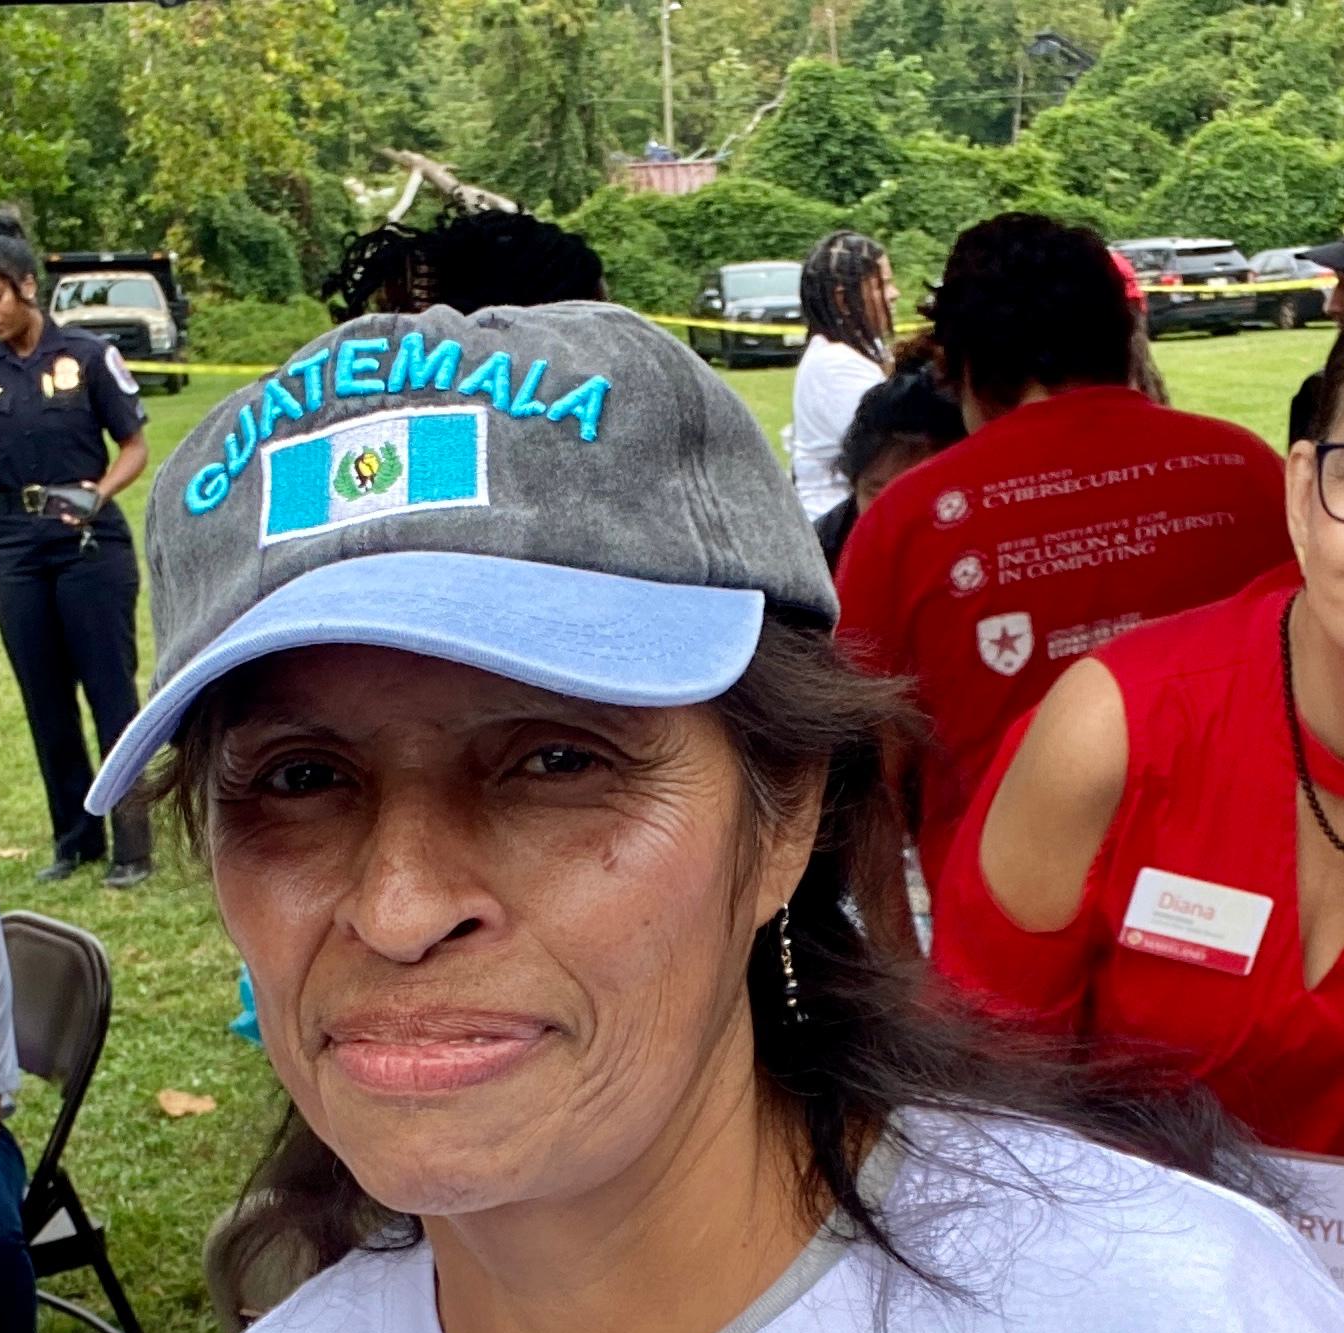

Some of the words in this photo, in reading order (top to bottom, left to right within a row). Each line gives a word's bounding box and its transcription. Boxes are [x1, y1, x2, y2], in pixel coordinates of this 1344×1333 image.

[184, 331, 611, 515] GUATEMALA
[983, 463, 1157, 509] CYBERSECURITY
[1165, 453, 1246, 471] CENTER
[984, 469, 1072, 493] MARYLAND
[998, 536, 1109, 569] INCLUSION
[1114, 533, 1129, 545] &
[1135, 511, 1237, 540] DIVERSITY
[999, 567, 1022, 585] IN
[1027, 541, 1156, 579] COMPUTING
[1159, 891, 1216, 921] Diana
